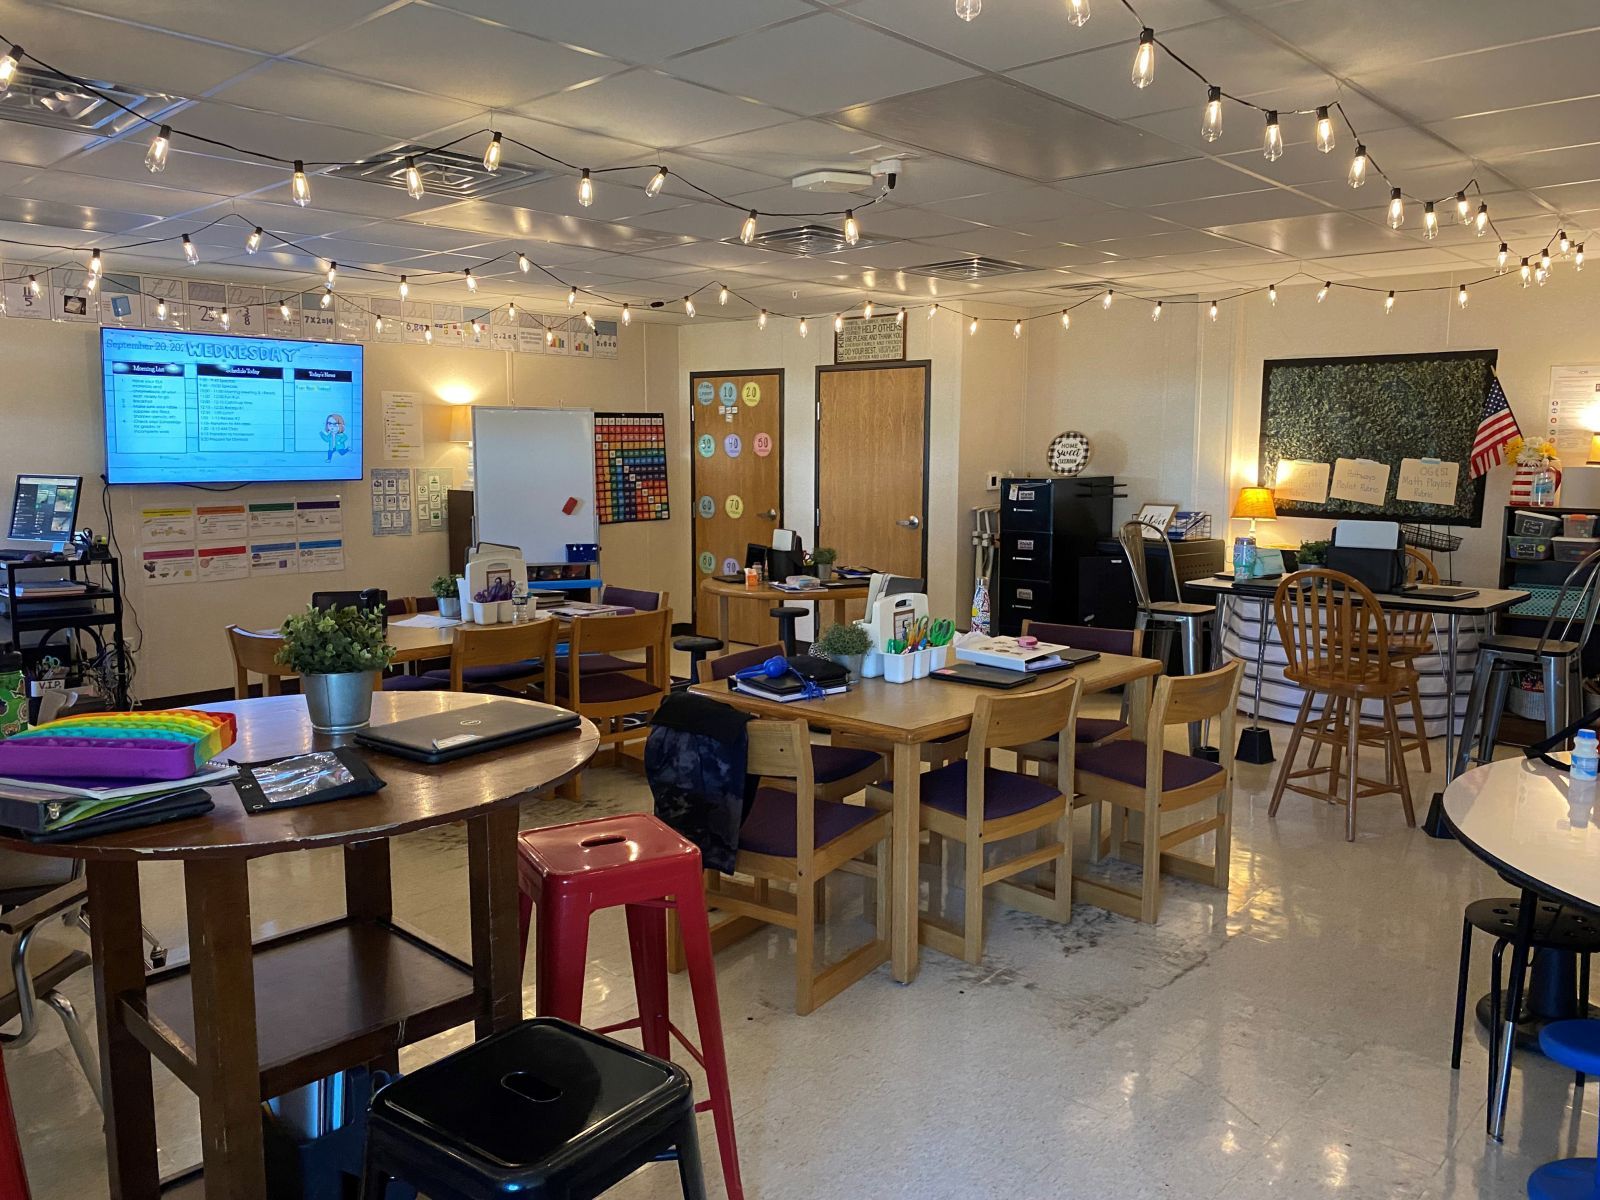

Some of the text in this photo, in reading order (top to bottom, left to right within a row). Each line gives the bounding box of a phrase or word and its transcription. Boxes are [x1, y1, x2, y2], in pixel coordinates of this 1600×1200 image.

[862, 323, 902, 333] HELP OTHERS
[106, 338, 153, 350] September
[187, 341, 297, 362] WEDNESDAY
[133, 364, 156, 373] Morning
[723, 386, 733, 398] 10
[745, 386, 757, 398] 20
[728, 437, 739, 449] 40
[757, 437, 769, 448] 50
[1402, 476, 1423, 486] Math
[702, 499, 712, 511] 60
[729, 499, 740, 510] 70
[726, 562, 736, 573] 90
[39, 681, 62, 689] V.I.P.
